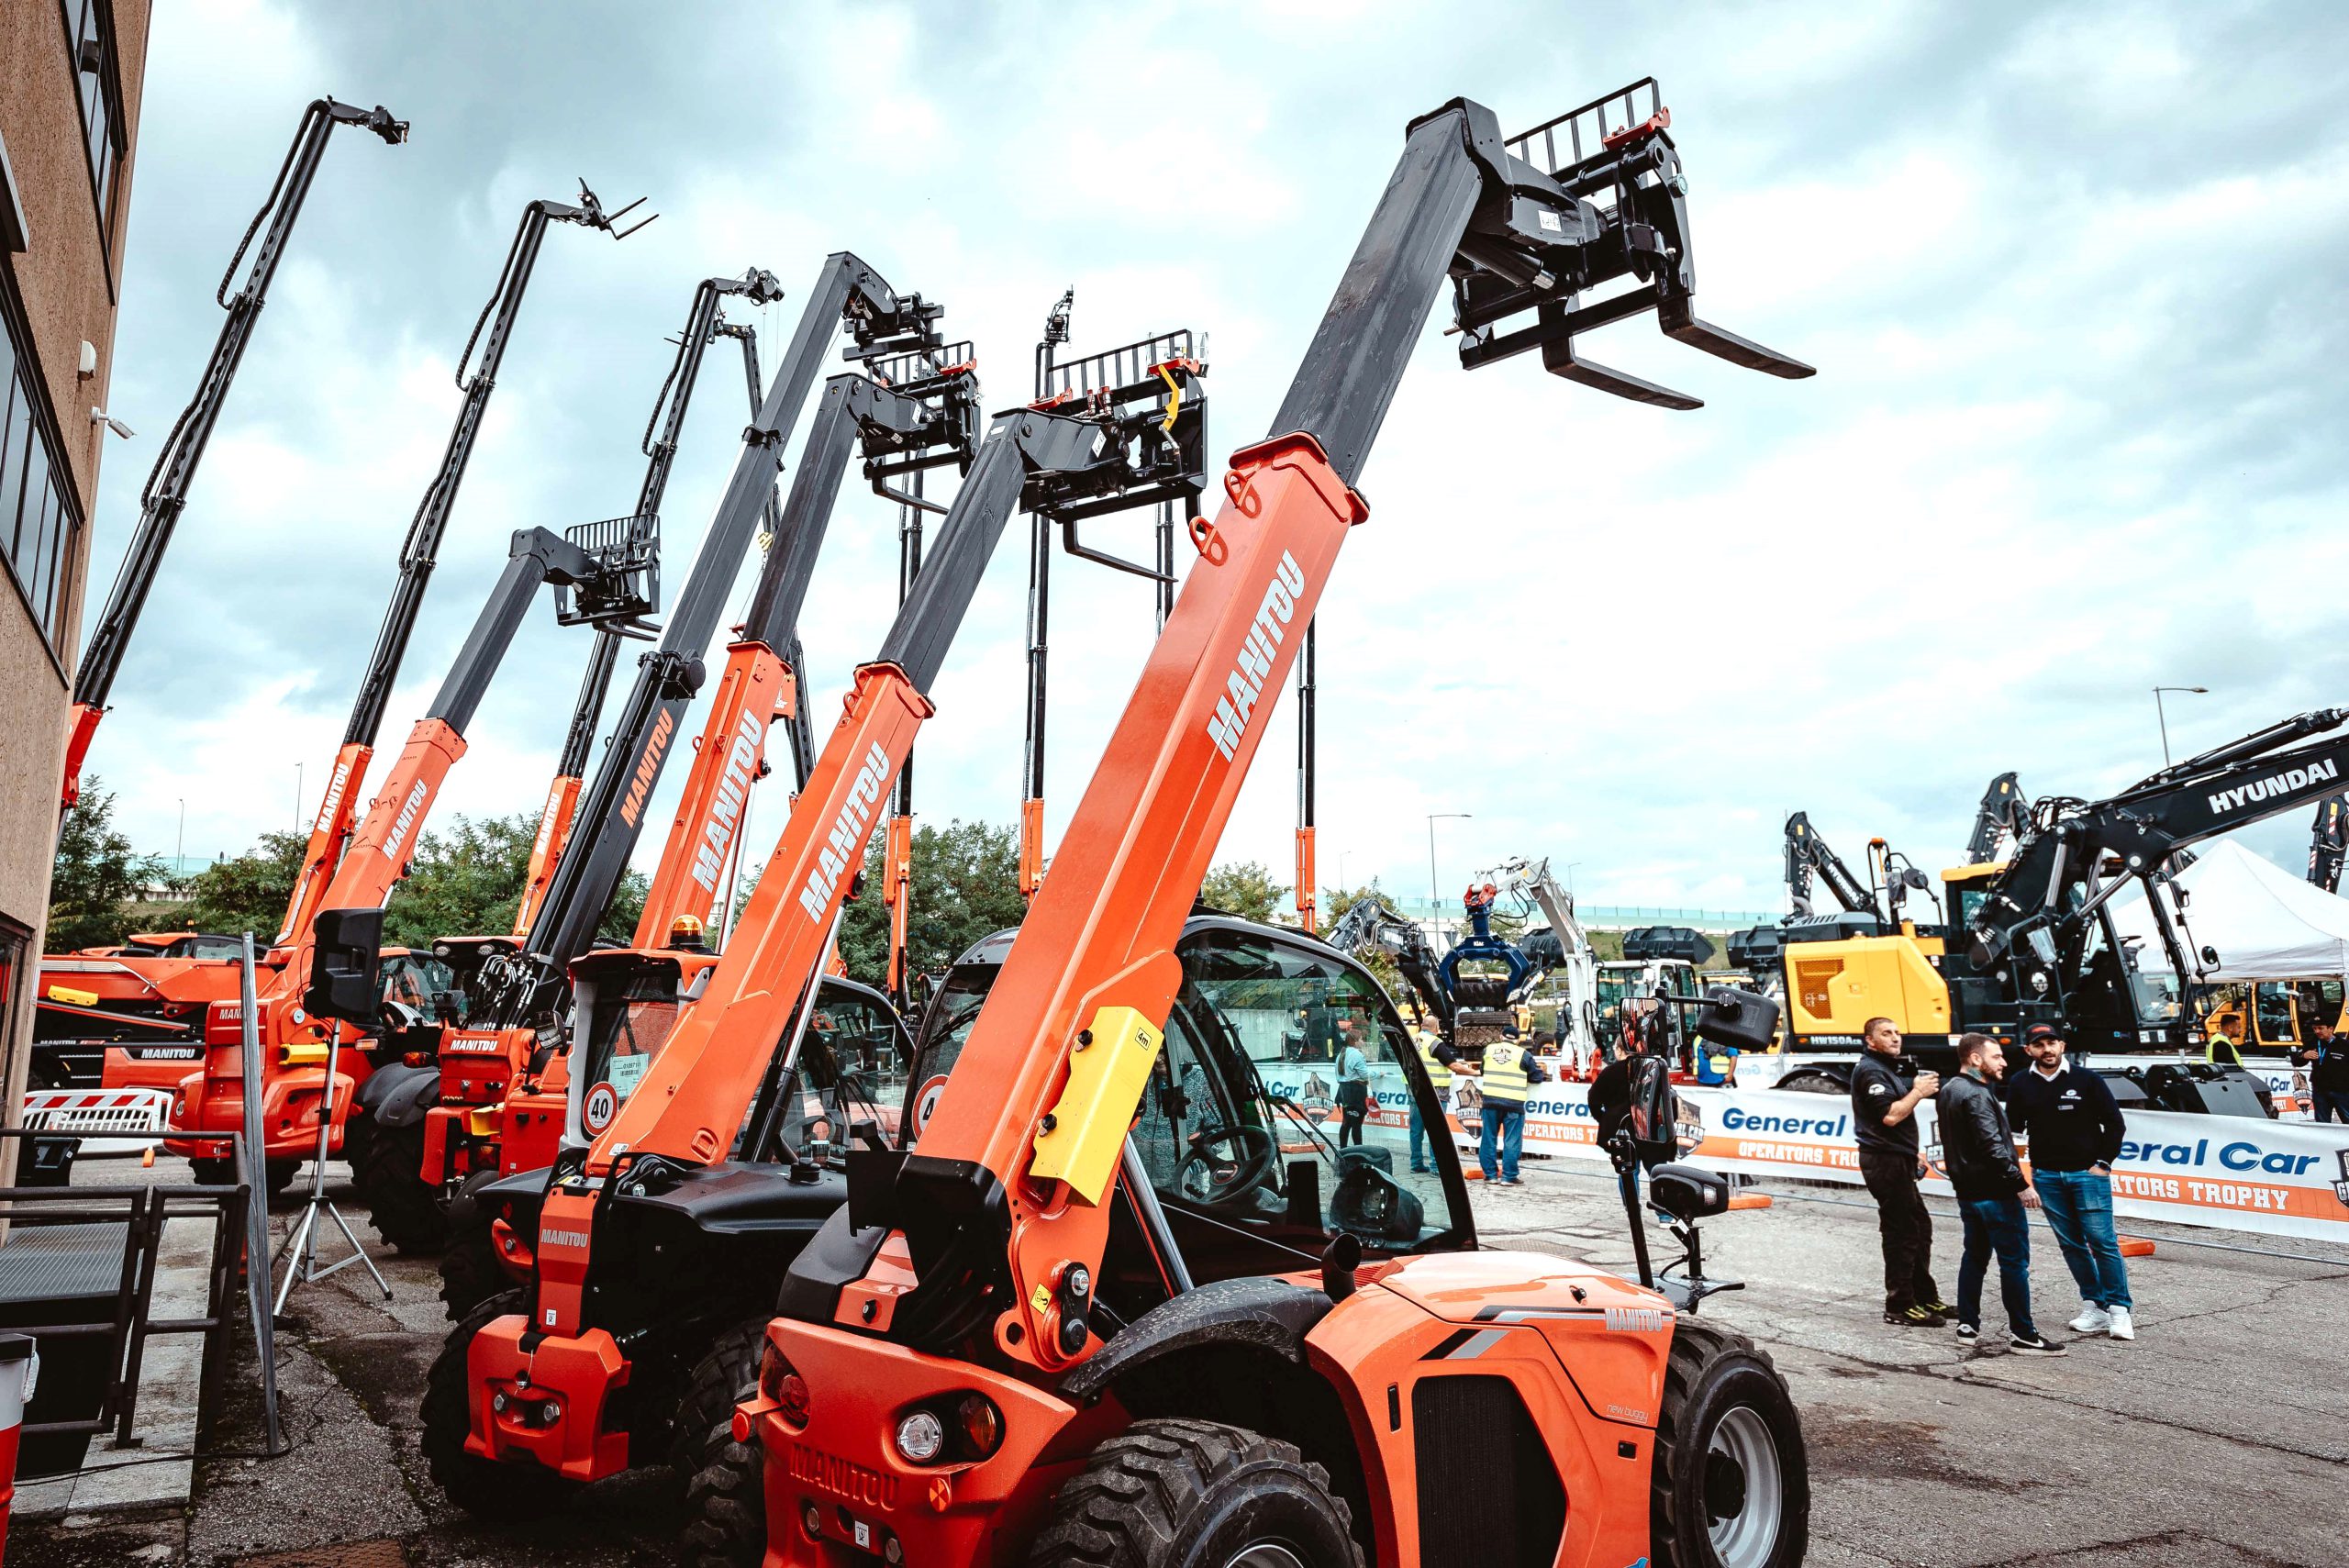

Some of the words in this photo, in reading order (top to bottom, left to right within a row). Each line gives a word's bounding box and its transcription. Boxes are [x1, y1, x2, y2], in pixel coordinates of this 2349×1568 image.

[1207, 549, 1305, 763] MANITOU
[620, 707, 674, 828] MANITOU
[317, 762, 350, 834] MANITOU
[692, 708, 762, 894] MANITOU
[2208, 758, 2339, 815] HYUNDAI
[382, 778, 428, 861] MANITOU
[535, 792, 561, 856] MANITOU
[798, 740, 890, 926] MANITOU
[140, 1048, 195, 1059] MANITOU
[451, 1040, 498, 1051] MANITOU
[1137, 1032, 1149, 1047] 4m
[1271, 1081, 1299, 1097] Car
[2270, 1076, 2290, 1092] Car
[591, 1097, 609, 1118] 40
[1525, 1100, 1592, 1118] enera
[1722, 1107, 1846, 1137] General
[1739, 1141, 1823, 1163] OPERATORS
[1829, 1149, 1860, 1167] TRO
[2117, 1139, 2209, 1166] eral
[2219, 1141, 2321, 1175] Car
[2110, 1174, 2180, 1199] ATORS
[2188, 1181, 2288, 1210] TROPHY
[540, 1229, 589, 1248] MANITOU
[1605, 1308, 1662, 1332] MANITOU
[1607, 1405, 1624, 1415] new
[1624, 1406, 1649, 1423] buggy
[790, 1442, 900, 1511] MANITOU
